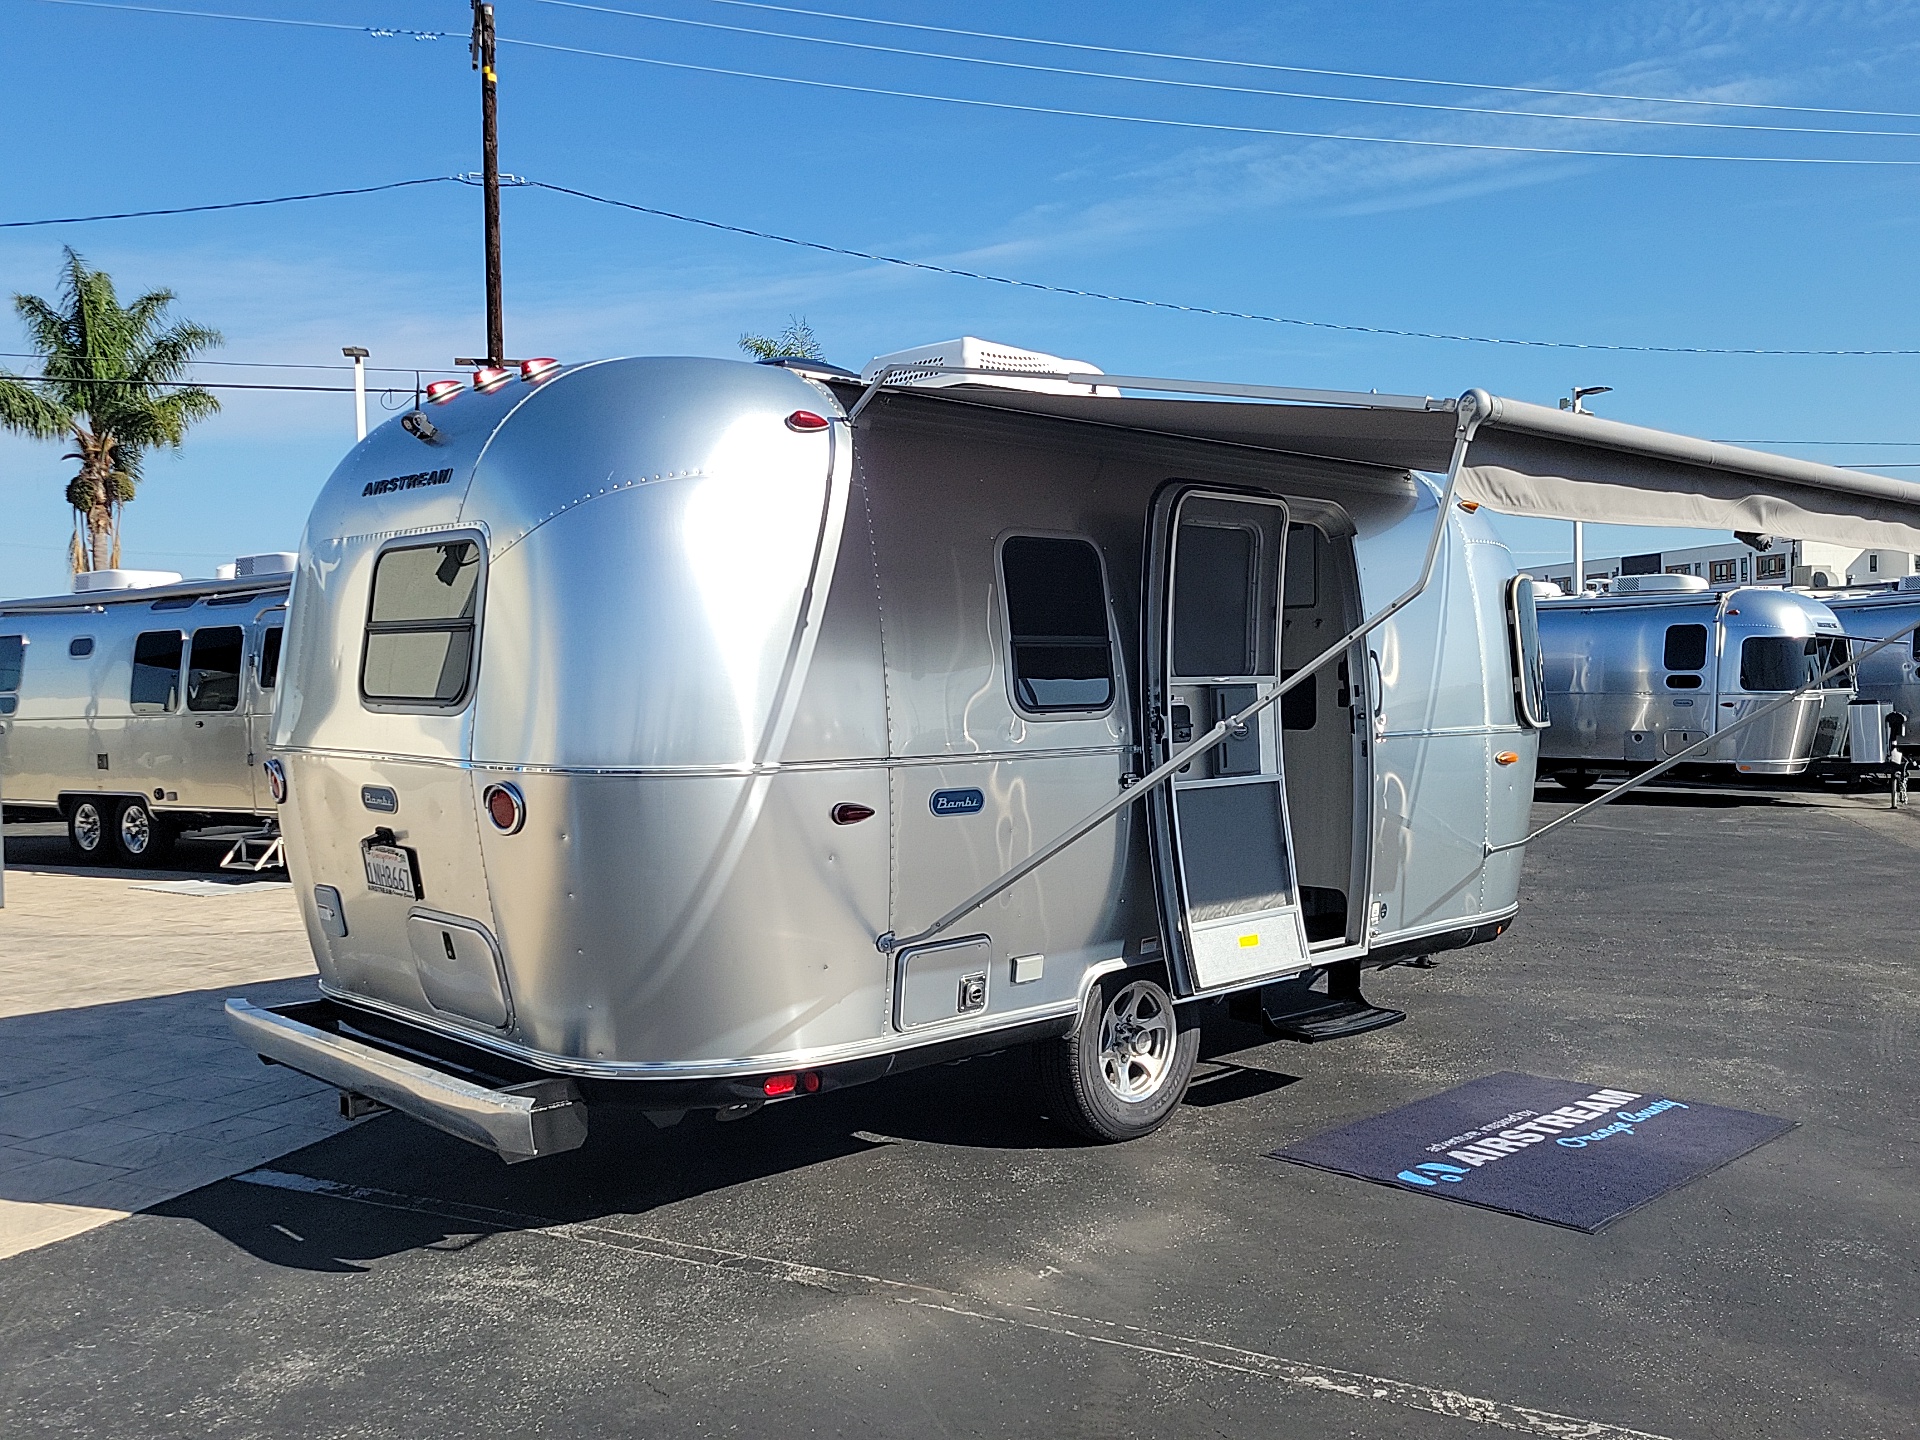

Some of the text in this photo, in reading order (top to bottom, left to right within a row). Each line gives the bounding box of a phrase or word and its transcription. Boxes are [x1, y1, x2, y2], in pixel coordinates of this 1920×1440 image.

[362, 468, 454, 497] AIRSTREAM
[364, 792, 393, 806] Bambi
[937, 796, 979, 809] Bambi
[1447, 1089, 1642, 1167] AIRSTREAM
[1556, 1098, 1690, 1148] Orange County
